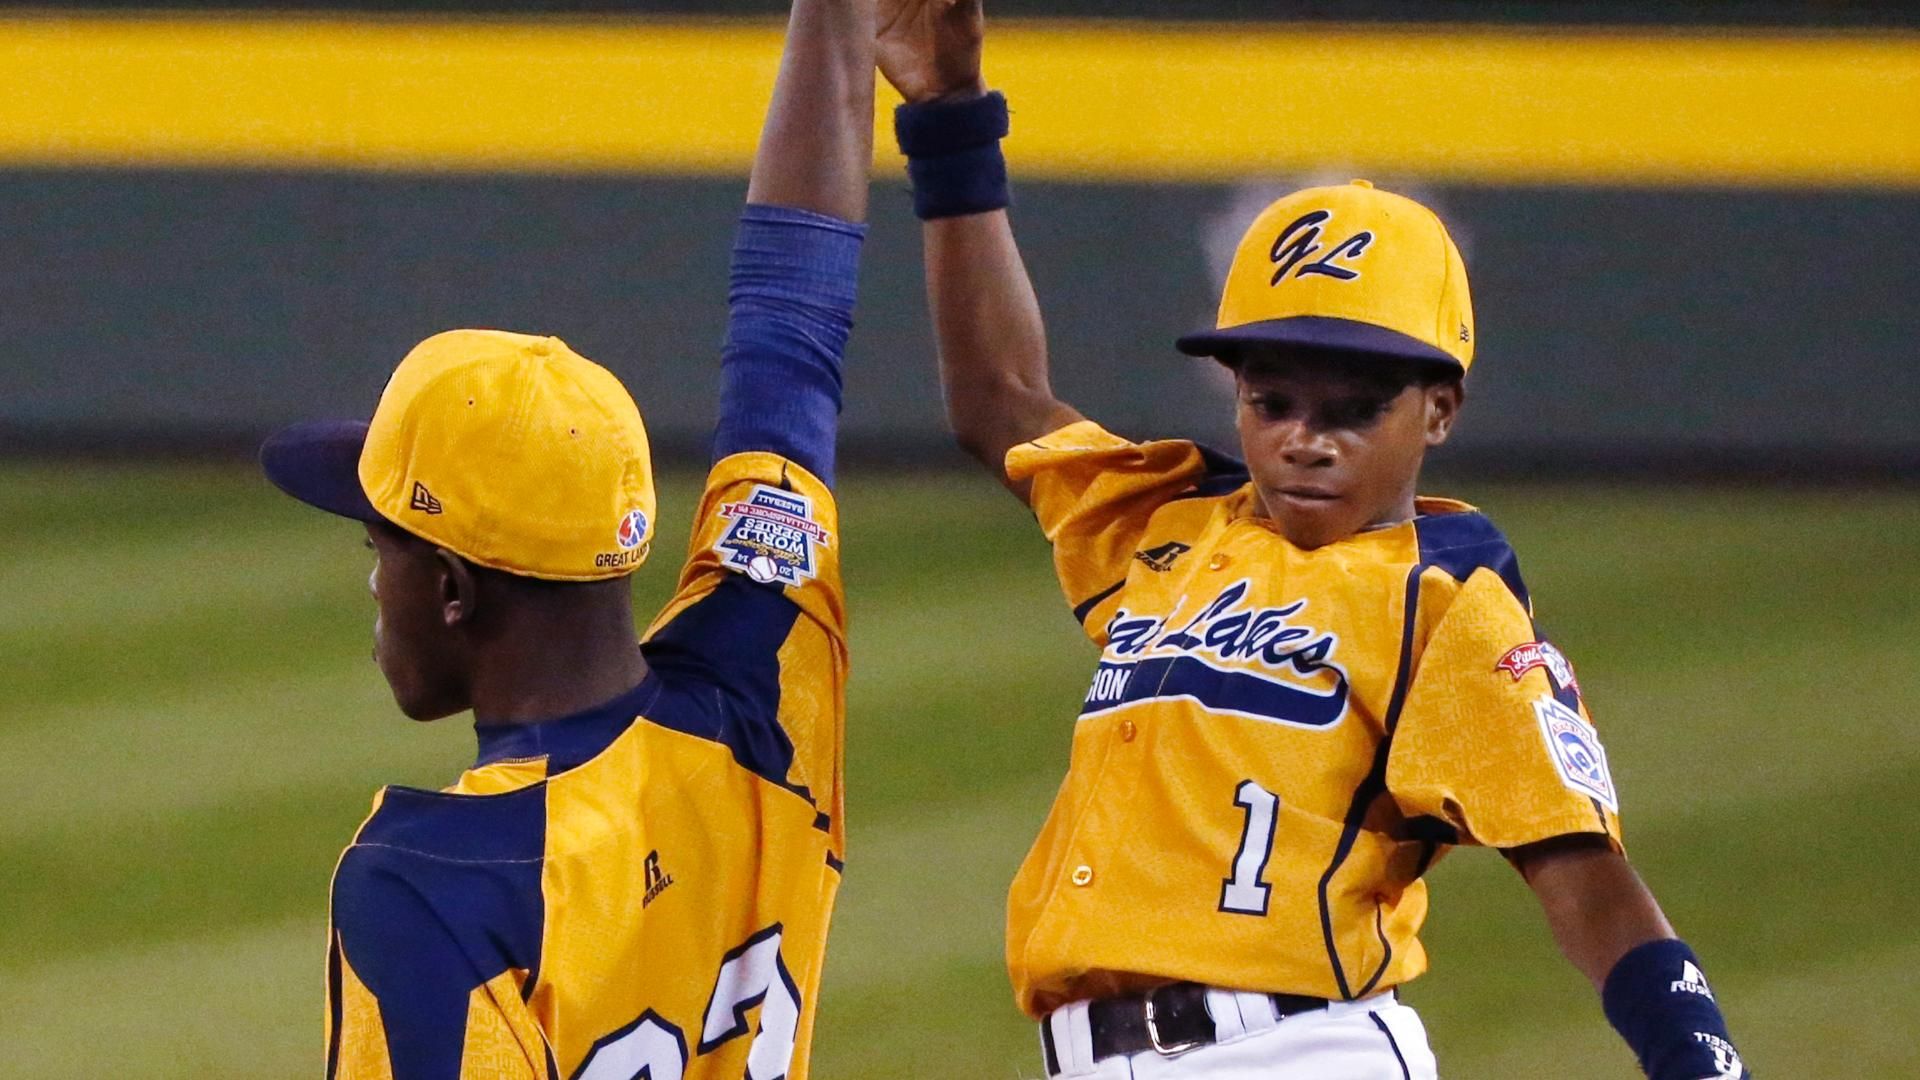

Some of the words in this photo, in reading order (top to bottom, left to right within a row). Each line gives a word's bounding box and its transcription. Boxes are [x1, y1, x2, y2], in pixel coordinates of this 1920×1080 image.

[758, 493, 804, 514] BASEBALL
[735, 527, 805, 557] WORLD
[744, 518, 803, 543] SERIES
[595, 551, 629, 567] GREAT
[737, 553, 750, 563] 14
[779, 565, 792, 576] 20
[1156, 579, 1335, 676] Lakes
[1084, 668, 1132, 704] ION
[1217, 778, 1280, 917] 1
[642, 873, 674, 910] RUSSELL
